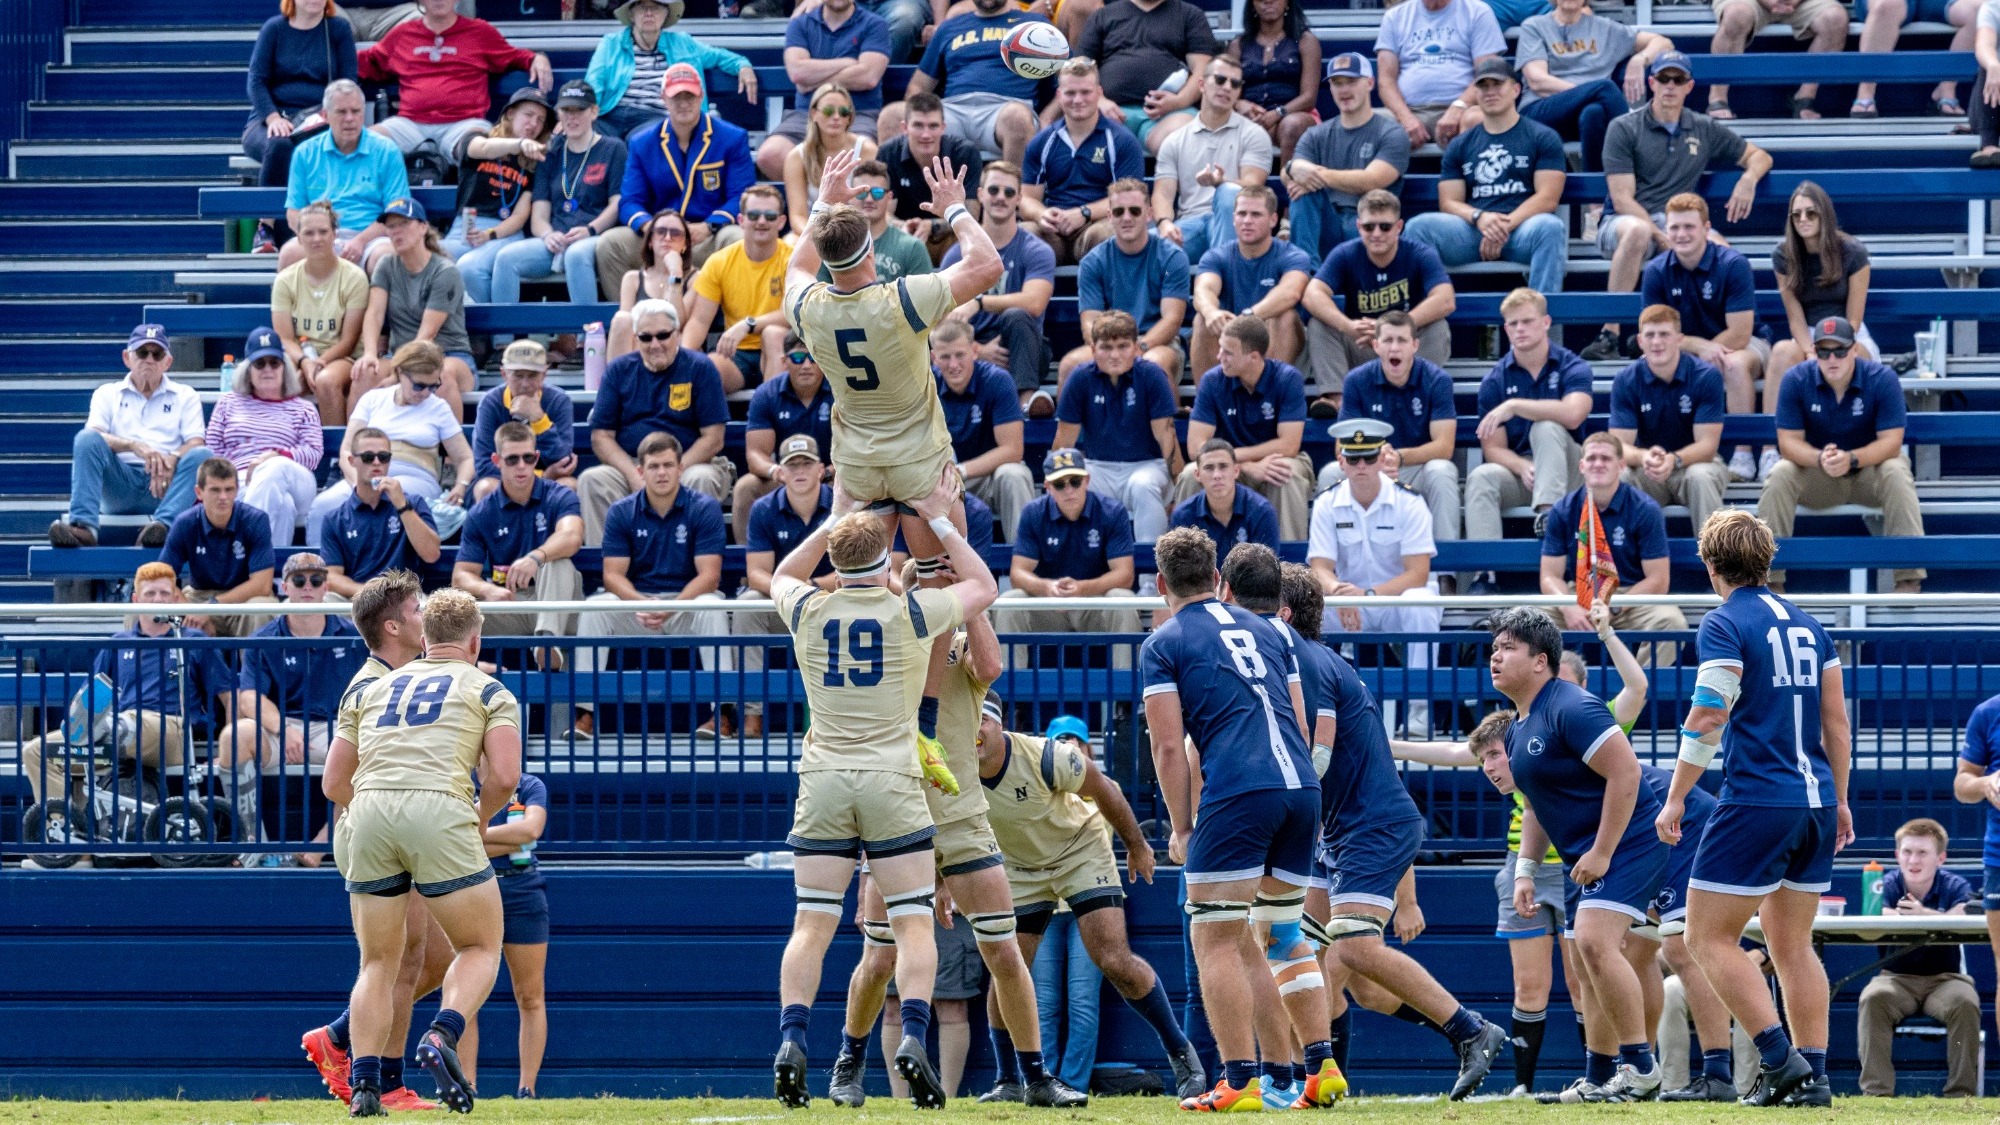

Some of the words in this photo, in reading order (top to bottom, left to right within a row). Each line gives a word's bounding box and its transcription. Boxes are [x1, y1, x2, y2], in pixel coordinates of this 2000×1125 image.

[982, 27, 1010, 41] NAV
[1552, 39, 1597, 54] UNA
[1358, 279, 1410, 311] RUGBY
[292, 317, 336, 331] RUGB
[834, 328, 881, 392] 5
[164, 404, 171, 413] N
[1053, 453, 1075, 469] N
[822, 618, 884, 688] 19
[1219, 629, 1268, 679] 8
[1766, 626, 1818, 688] 16
[375, 674, 454, 729] 18
[1014, 786, 1028, 799] N
